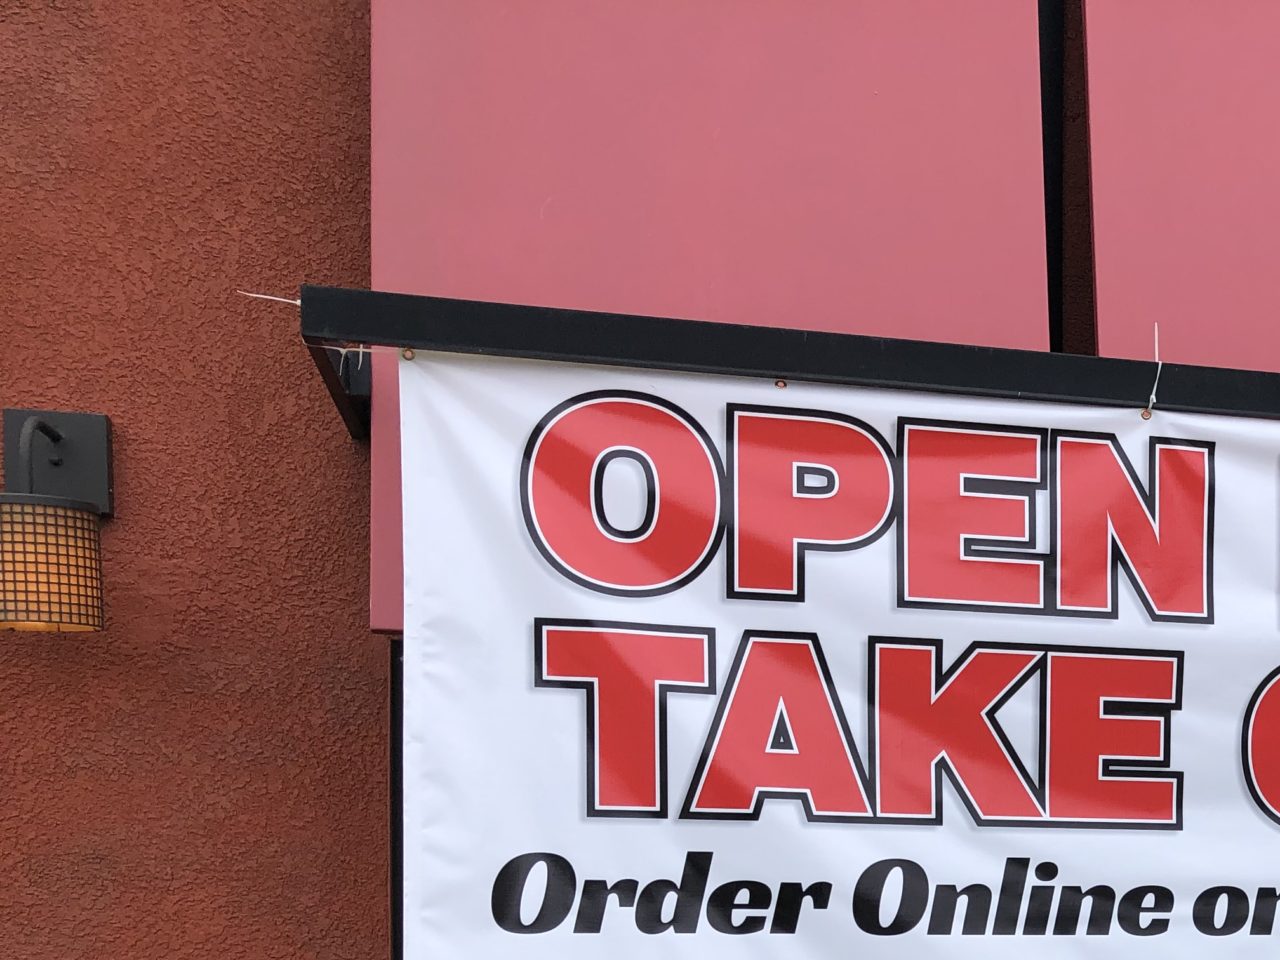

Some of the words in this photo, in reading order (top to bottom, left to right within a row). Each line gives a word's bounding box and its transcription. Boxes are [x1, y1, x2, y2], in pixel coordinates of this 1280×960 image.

[520, 388, 1216, 624] OPEN
[534, 617, 1184, 831] TAKE
[490, 851, 832, 935] Order
[851, 857, 1174, 936] Online
